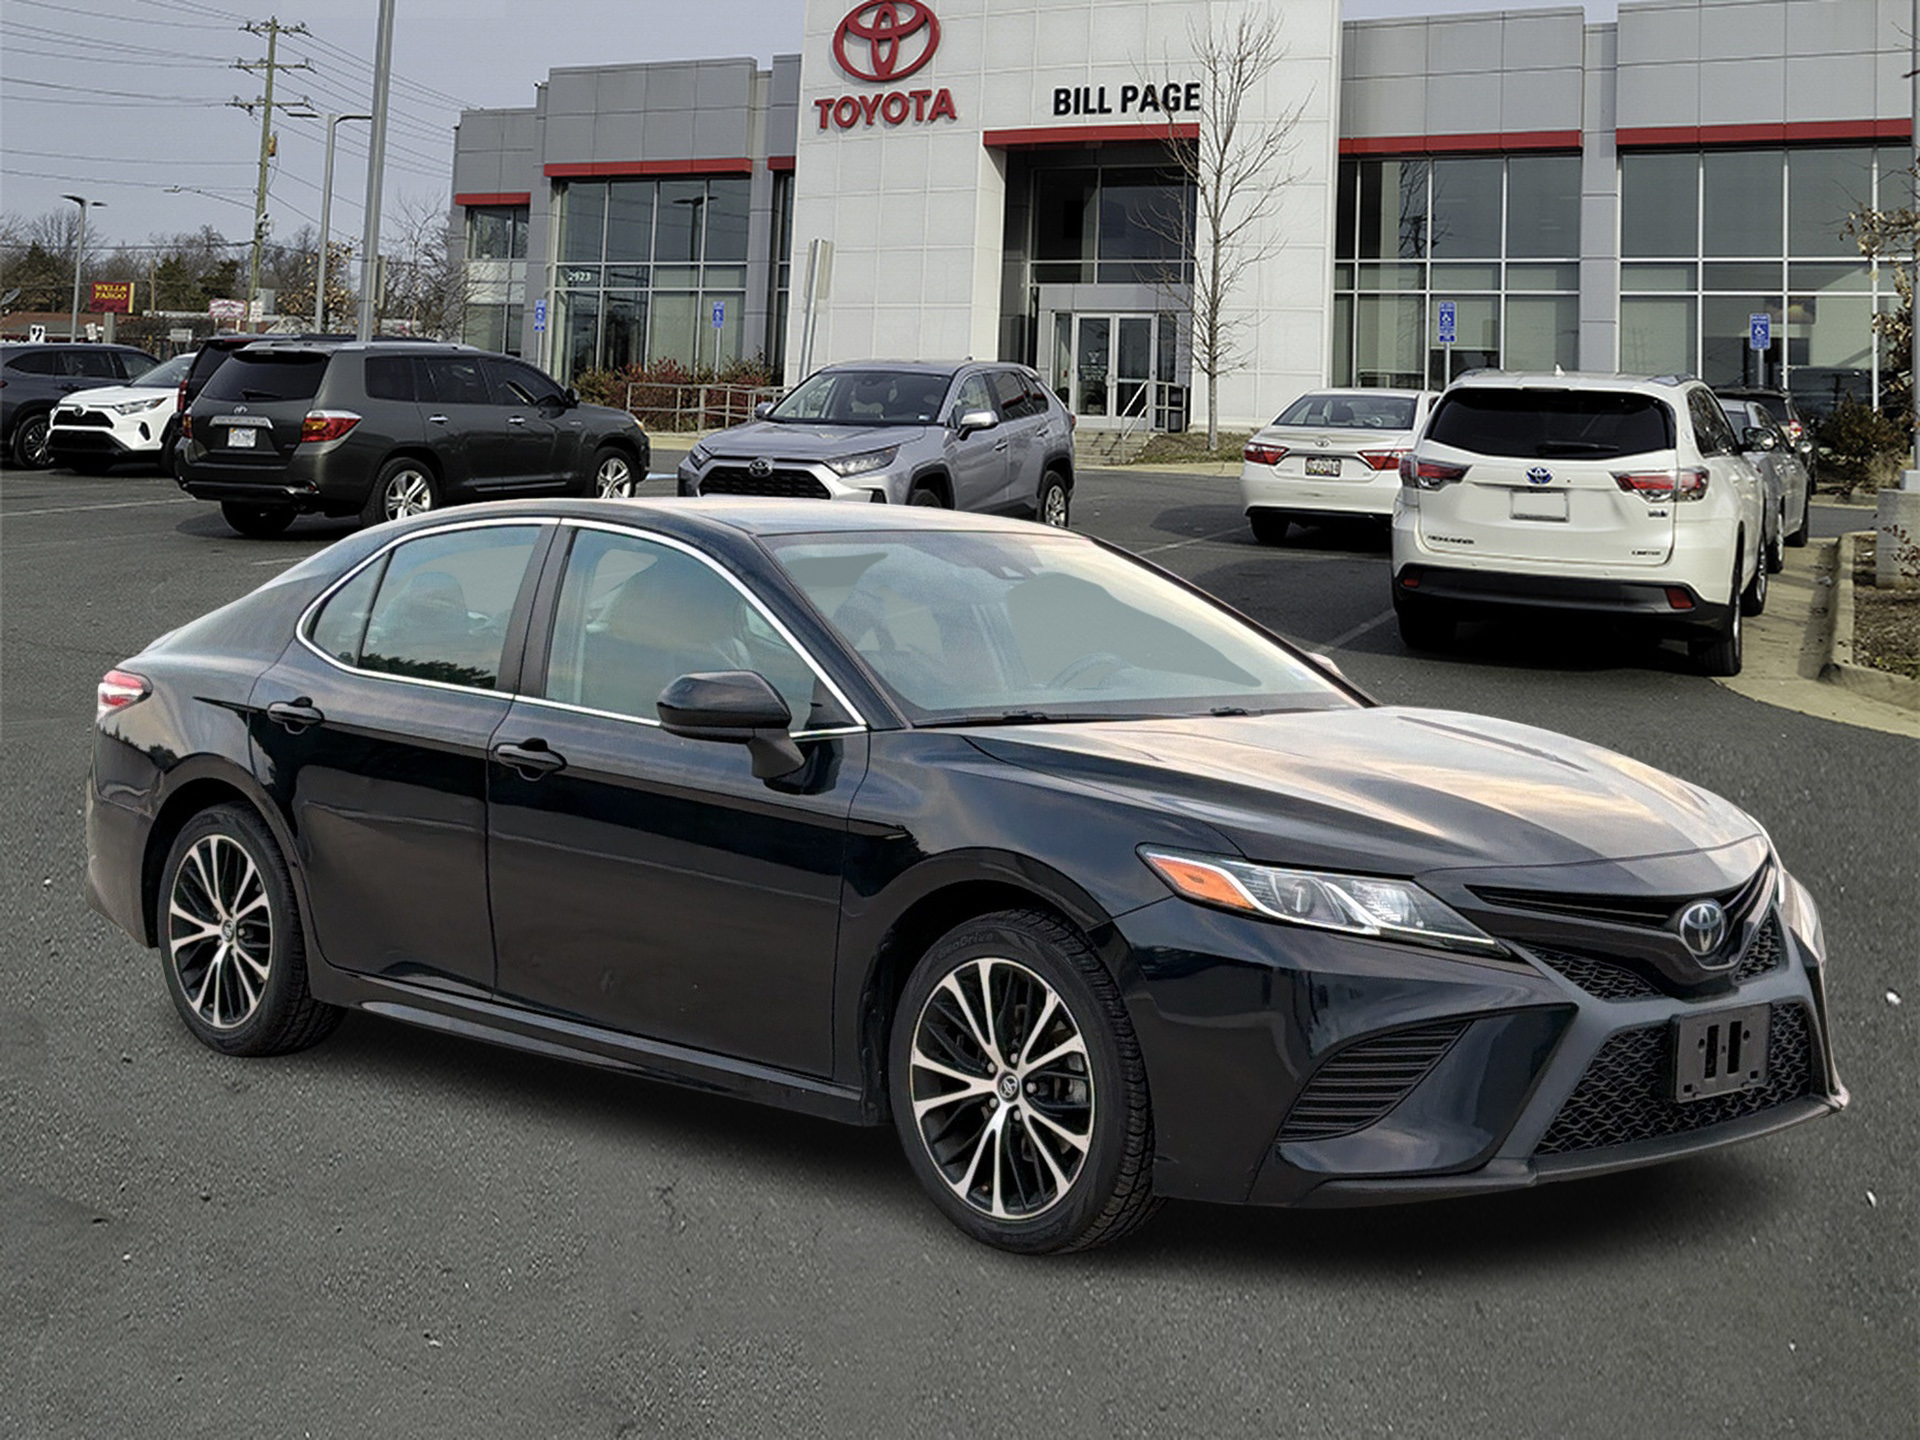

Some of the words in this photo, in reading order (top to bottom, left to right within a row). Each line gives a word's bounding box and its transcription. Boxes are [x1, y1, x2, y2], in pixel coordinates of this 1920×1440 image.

[813, 88, 958, 130] TOYOTA
[1053, 86, 1113, 116] BILL
[1120, 82, 1201, 114] PAGE
[95, 283, 127, 291] WELLS
[95, 291, 127, 300] FARGO
